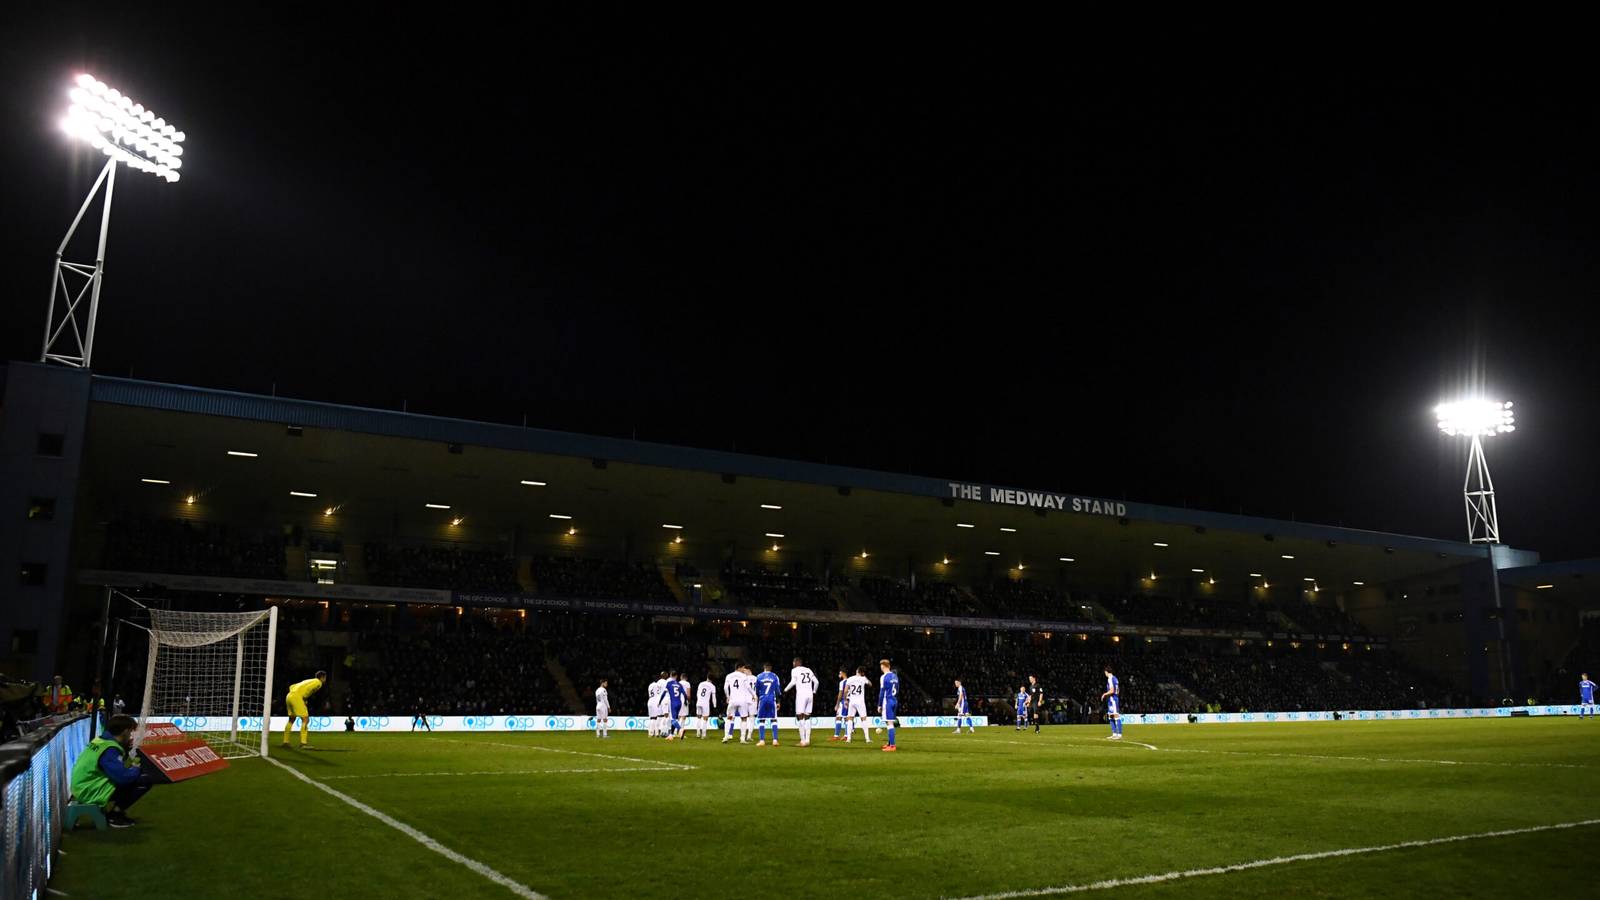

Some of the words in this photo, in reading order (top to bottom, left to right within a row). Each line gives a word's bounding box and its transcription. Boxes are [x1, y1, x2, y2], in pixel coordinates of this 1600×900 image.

[948, 483, 981, 500] THE
[990, 488, 1066, 510] MEDWAY
[1072, 498, 1126, 516] STAND
[800, 672, 812, 684] 23
[733, 679, 739, 689] 4
[764, 682, 772, 695] 7
[850, 684, 862, 695] 24
[673, 687, 680, 697] 5
[701, 688, 707, 697] 8
